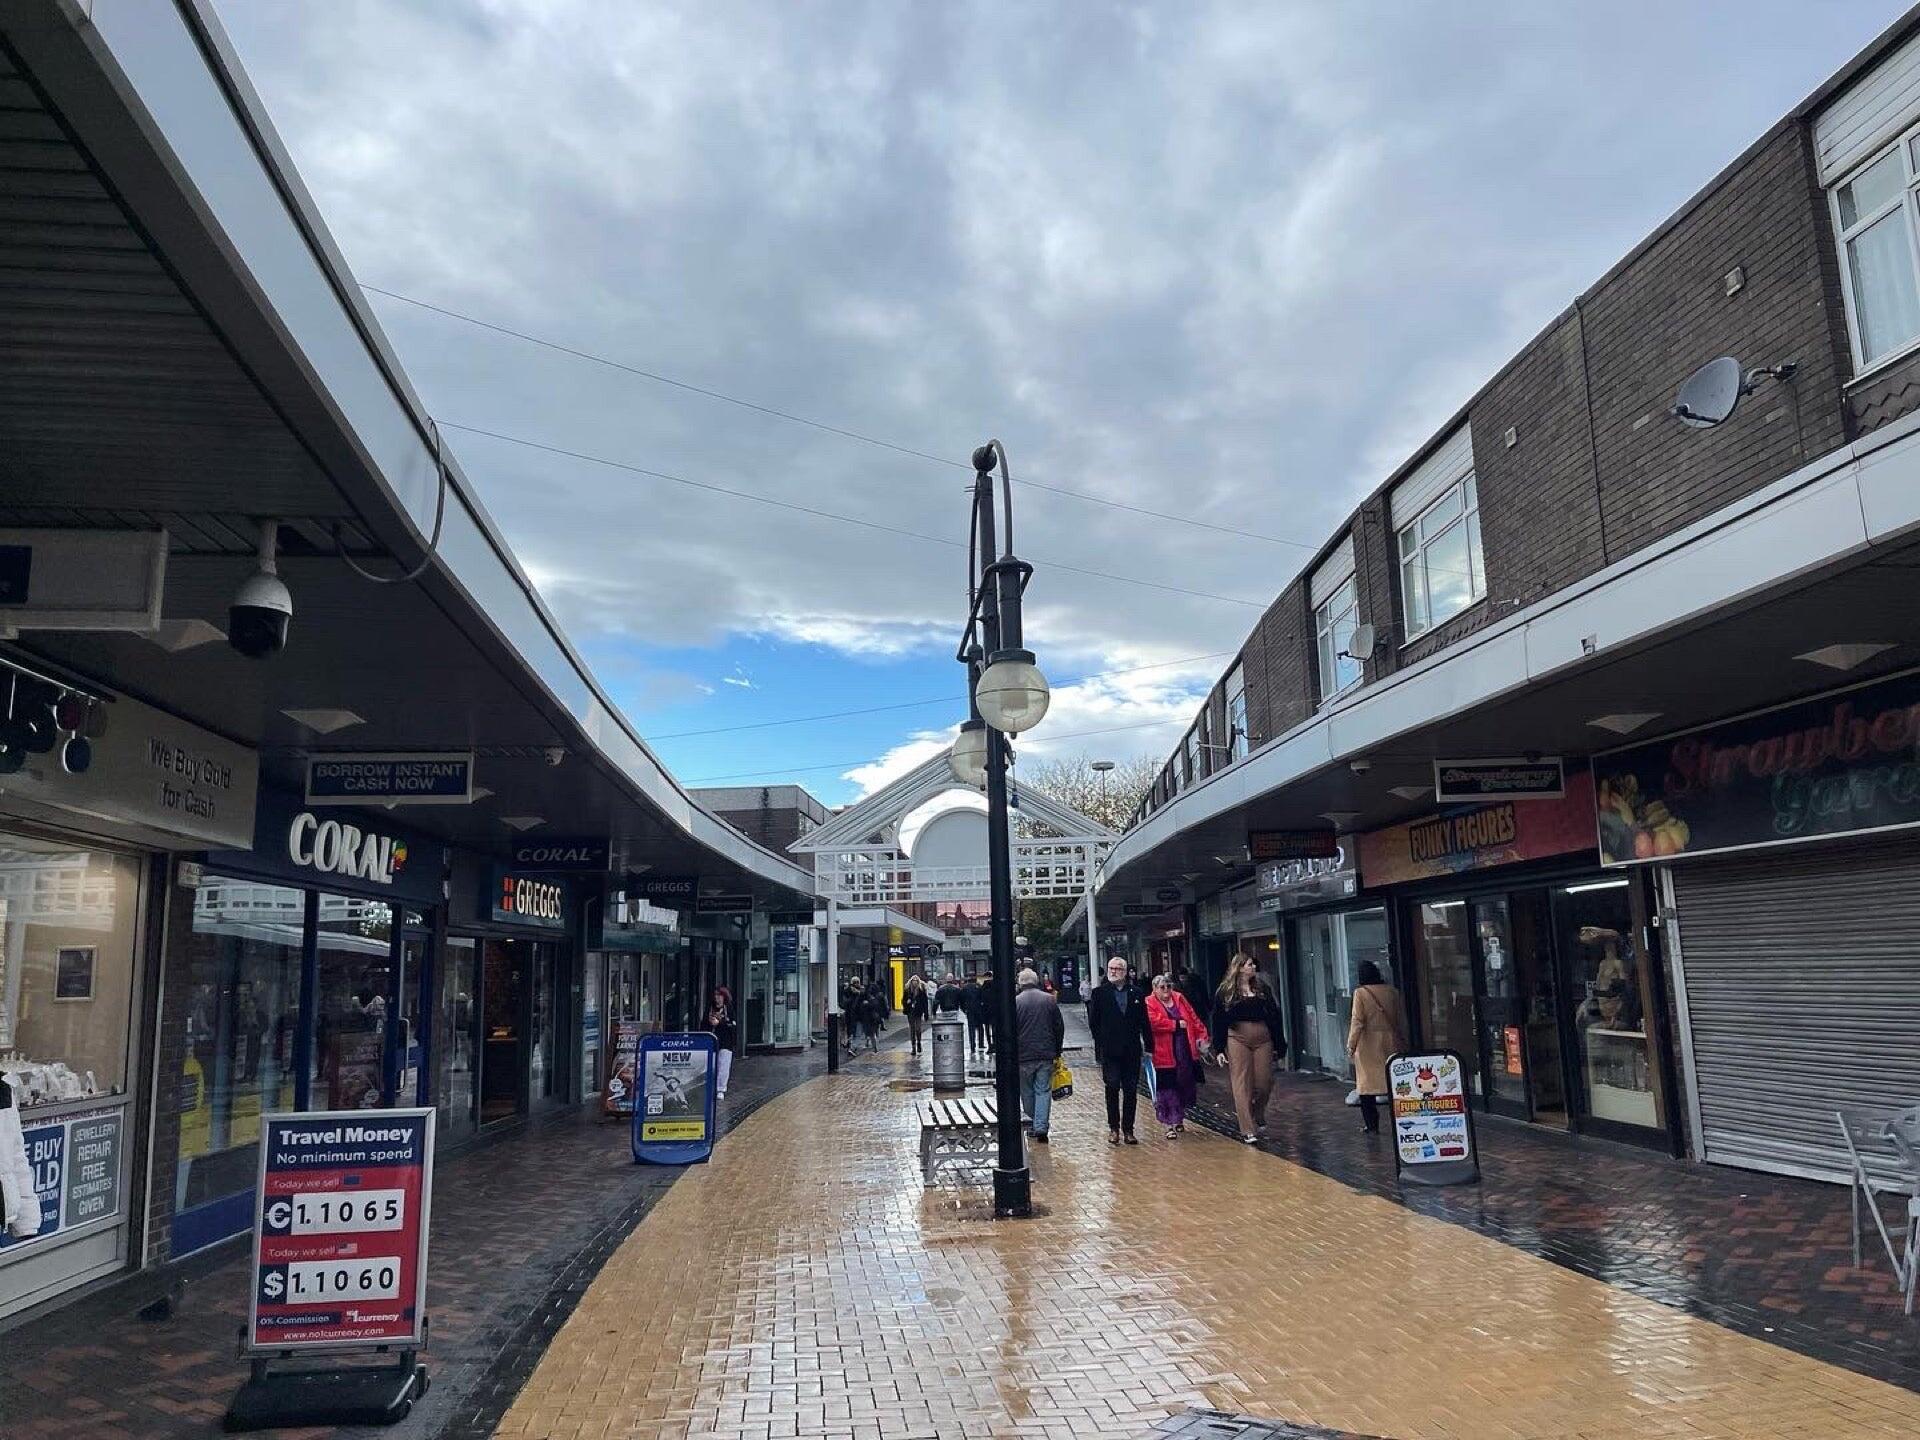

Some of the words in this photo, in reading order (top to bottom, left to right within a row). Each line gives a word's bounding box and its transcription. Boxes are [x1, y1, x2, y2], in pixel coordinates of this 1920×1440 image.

[148, 737, 172, 769] We
[174, 748, 200, 785] Buy
[203, 759, 232, 789] Gold
[317, 764, 392, 778] BORROW
[395, 763, 465, 776] INSTANT
[344, 778, 389, 790] CASH
[395, 778, 434, 790] NOW
[161, 781, 181, 808] for
[185, 789, 214, 819] Cash
[1411, 819, 1452, 862] FUNKY
[1455, 803, 1514, 852] FIGURES
[289, 812, 393, 884] CORAL
[516, 847, 593, 862] CORAL
[647, 882, 691, 893] GREGGS
[517, 878, 562, 920] GREGGS
[661, 1040, 690, 1048] CORAL
[662, 1052, 692, 1063] NEW
[1400, 1100, 1426, 1112] FUNKY
[1428, 1098, 1459, 1110] FIGURES
[73, 1123, 117, 1142] JEWELLERY
[280, 1128, 341, 1145] Travel
[345, 1127, 413, 1143] Money
[1400, 1133, 1430, 1144] NECA
[34, 1137, 62, 1162] BUY
[78, 1140, 111, 1162] REPAIR
[276, 1153, 297, 1164] No
[301, 1151, 366, 1164] minimum
[370, 1147, 412, 1161] spend
[82, 1161, 107, 1181] FREE
[72, 1177, 112, 1200] ESTIMATES
[273, 1179, 304, 1190] Today
[306, 1179, 321, 1187] we
[323, 1176, 340, 1187] sell
[78, 1196, 104, 1216] GIVEN
[267, 1247, 299, 1258] Today
[302, 1248, 318, 1256] we
[319, 1246, 336, 1255] sell
[276, 1314, 330, 1325] Commission
[283, 1327, 385, 1339] www.no1currency.com
